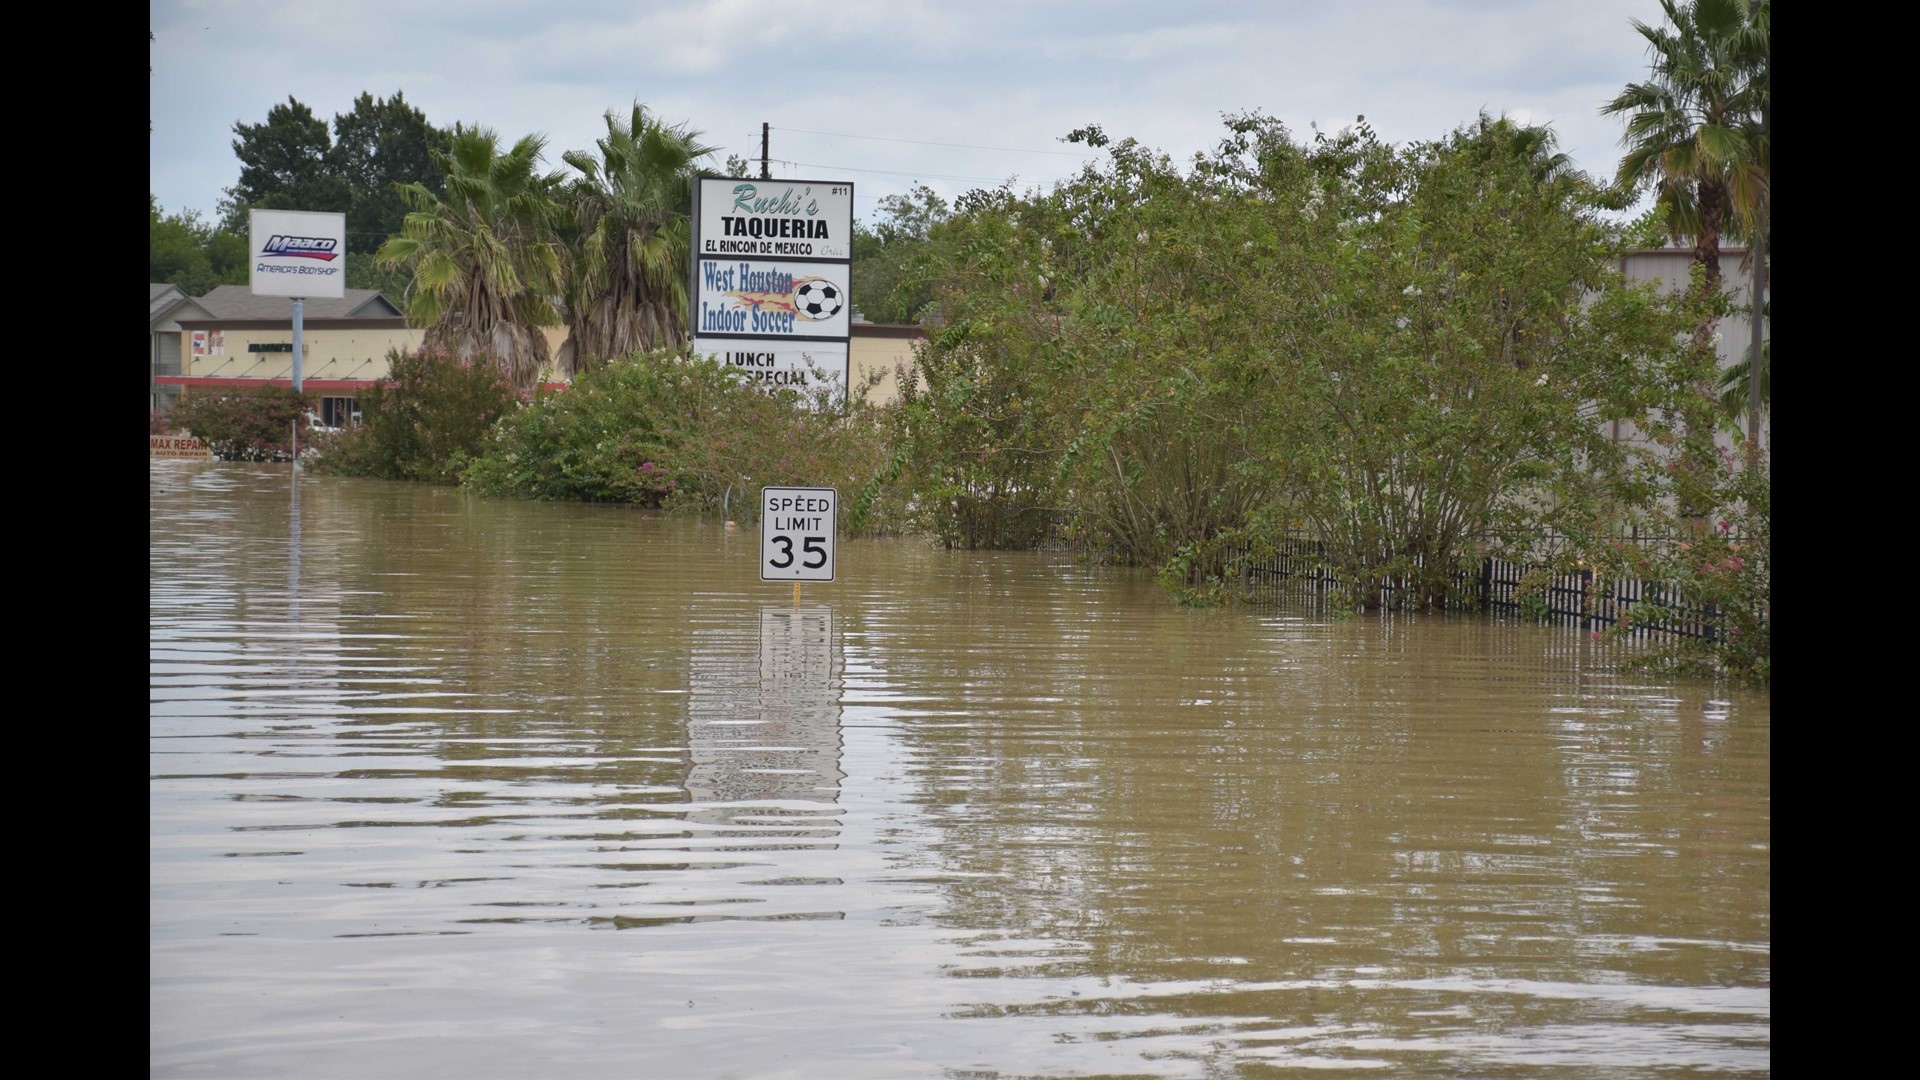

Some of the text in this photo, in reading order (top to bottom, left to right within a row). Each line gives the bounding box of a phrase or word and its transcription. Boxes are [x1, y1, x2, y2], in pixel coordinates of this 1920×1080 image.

[832, 187, 848, 195] #11
[732, 184, 819, 216] Ruchi's
[721, 217, 829, 239] TAQUERIA
[706, 240, 812, 255] EL RINCON DE MEXICO
[703, 261, 793, 294] West Houston
[702, 301, 795, 333] Indoor Soccer
[726, 352, 775, 367] LUNCH
[746, 370, 808, 386] SPECIAL
[174, 439, 208, 450] REPAIR
[769, 498, 829, 512] SPEED
[775, 517, 822, 531] LIMIT
[769, 535, 827, 570] 35
